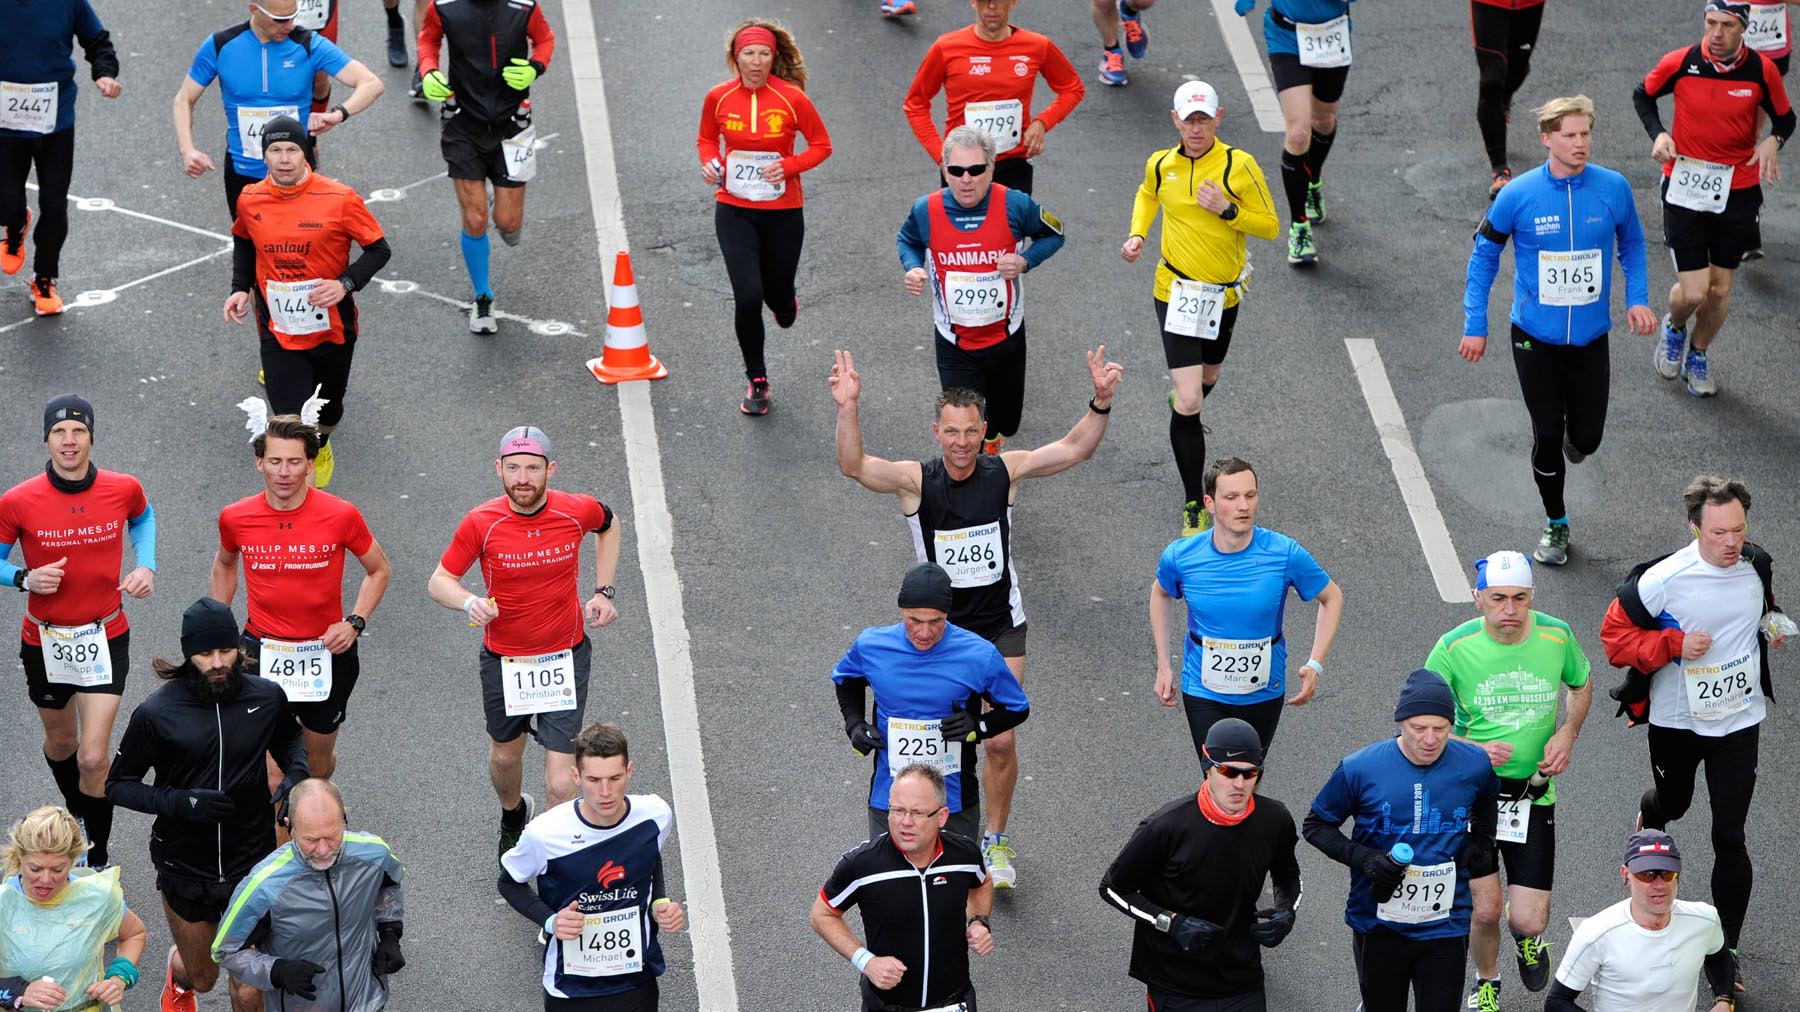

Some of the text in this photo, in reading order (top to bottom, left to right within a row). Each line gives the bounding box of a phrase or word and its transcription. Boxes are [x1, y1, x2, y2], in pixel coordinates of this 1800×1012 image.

[1305, 31, 1342, 52] 3199
[8, 97, 51, 114] 2447
[973, 115, 1015, 133] 2799
[735, 164, 764, 181] 279
[1678, 170, 1722, 192] 3968
[1535, 223, 1561, 232] aachen
[1541, 252, 1600, 262] METRO GROUP
[1547, 266, 1594, 284] 3165
[954, 287, 999, 306] 2999
[1558, 286, 1584, 295] Frank
[1177, 296, 1216, 316] 2317
[37, 520, 120, 539] PHILIP MES.DE
[937, 526, 999, 543] METRO GROUP
[41, 533, 117, 548] PERSONAL TRAINING
[241, 543, 338, 555] PHILIP MES.DE
[498, 551, 535, 562] PHILIP
[502, 552, 575, 569] PERSONAL TRAINING
[944, 542, 995, 566] 2486
[284, 559, 330, 570] FRONTRUNNER
[956, 564, 988, 576] Jürgen
[73, 626, 103, 640] GROUP
[52, 642, 99, 663] 3389
[1205, 640, 1270, 651] METRO GROUP
[269, 657, 322, 677] 4815
[1210, 653, 1262, 673] 2239
[1686, 654, 1750, 677] METRO GROUP
[282, 678, 310, 689] Philip
[513, 667, 565, 690] 1105
[1224, 674, 1248, 683] Marc
[1697, 671, 1747, 700] 2678
[519, 688, 562, 700] Christian
[1704, 690, 1745, 709] Reinhard
[898, 737, 948, 756] 2251
[1422, 866, 1454, 878] GROUP
[578, 887, 638, 905] SwissLife
[1392, 882, 1446, 902] 3919
[1401, 902, 1434, 912] Marco
[602, 910, 638, 924] GROUP
[579, 928, 632, 952] 1488
[583, 951, 624, 964] Michael
[624, 961, 640, 970] DUS
